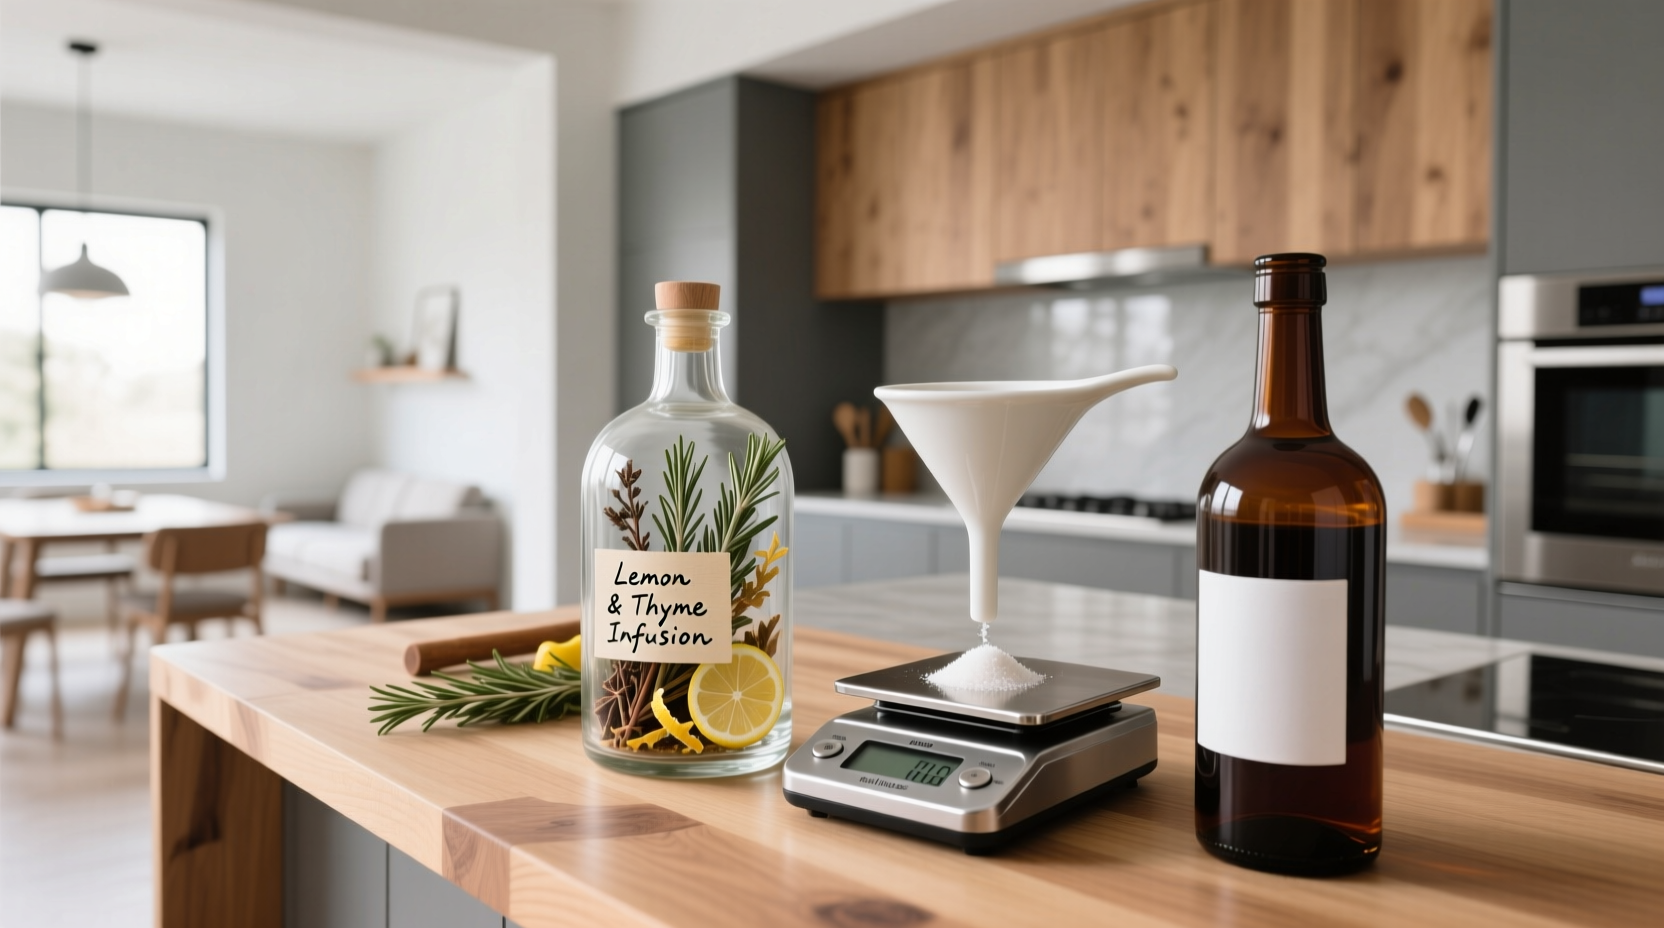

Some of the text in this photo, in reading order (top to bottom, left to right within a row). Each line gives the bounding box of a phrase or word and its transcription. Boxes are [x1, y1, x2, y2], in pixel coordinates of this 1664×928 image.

[614, 561, 691, 586] Lemon
[607, 592, 707, 627] & Thyme
[607, 621, 713, 653] Infusion
